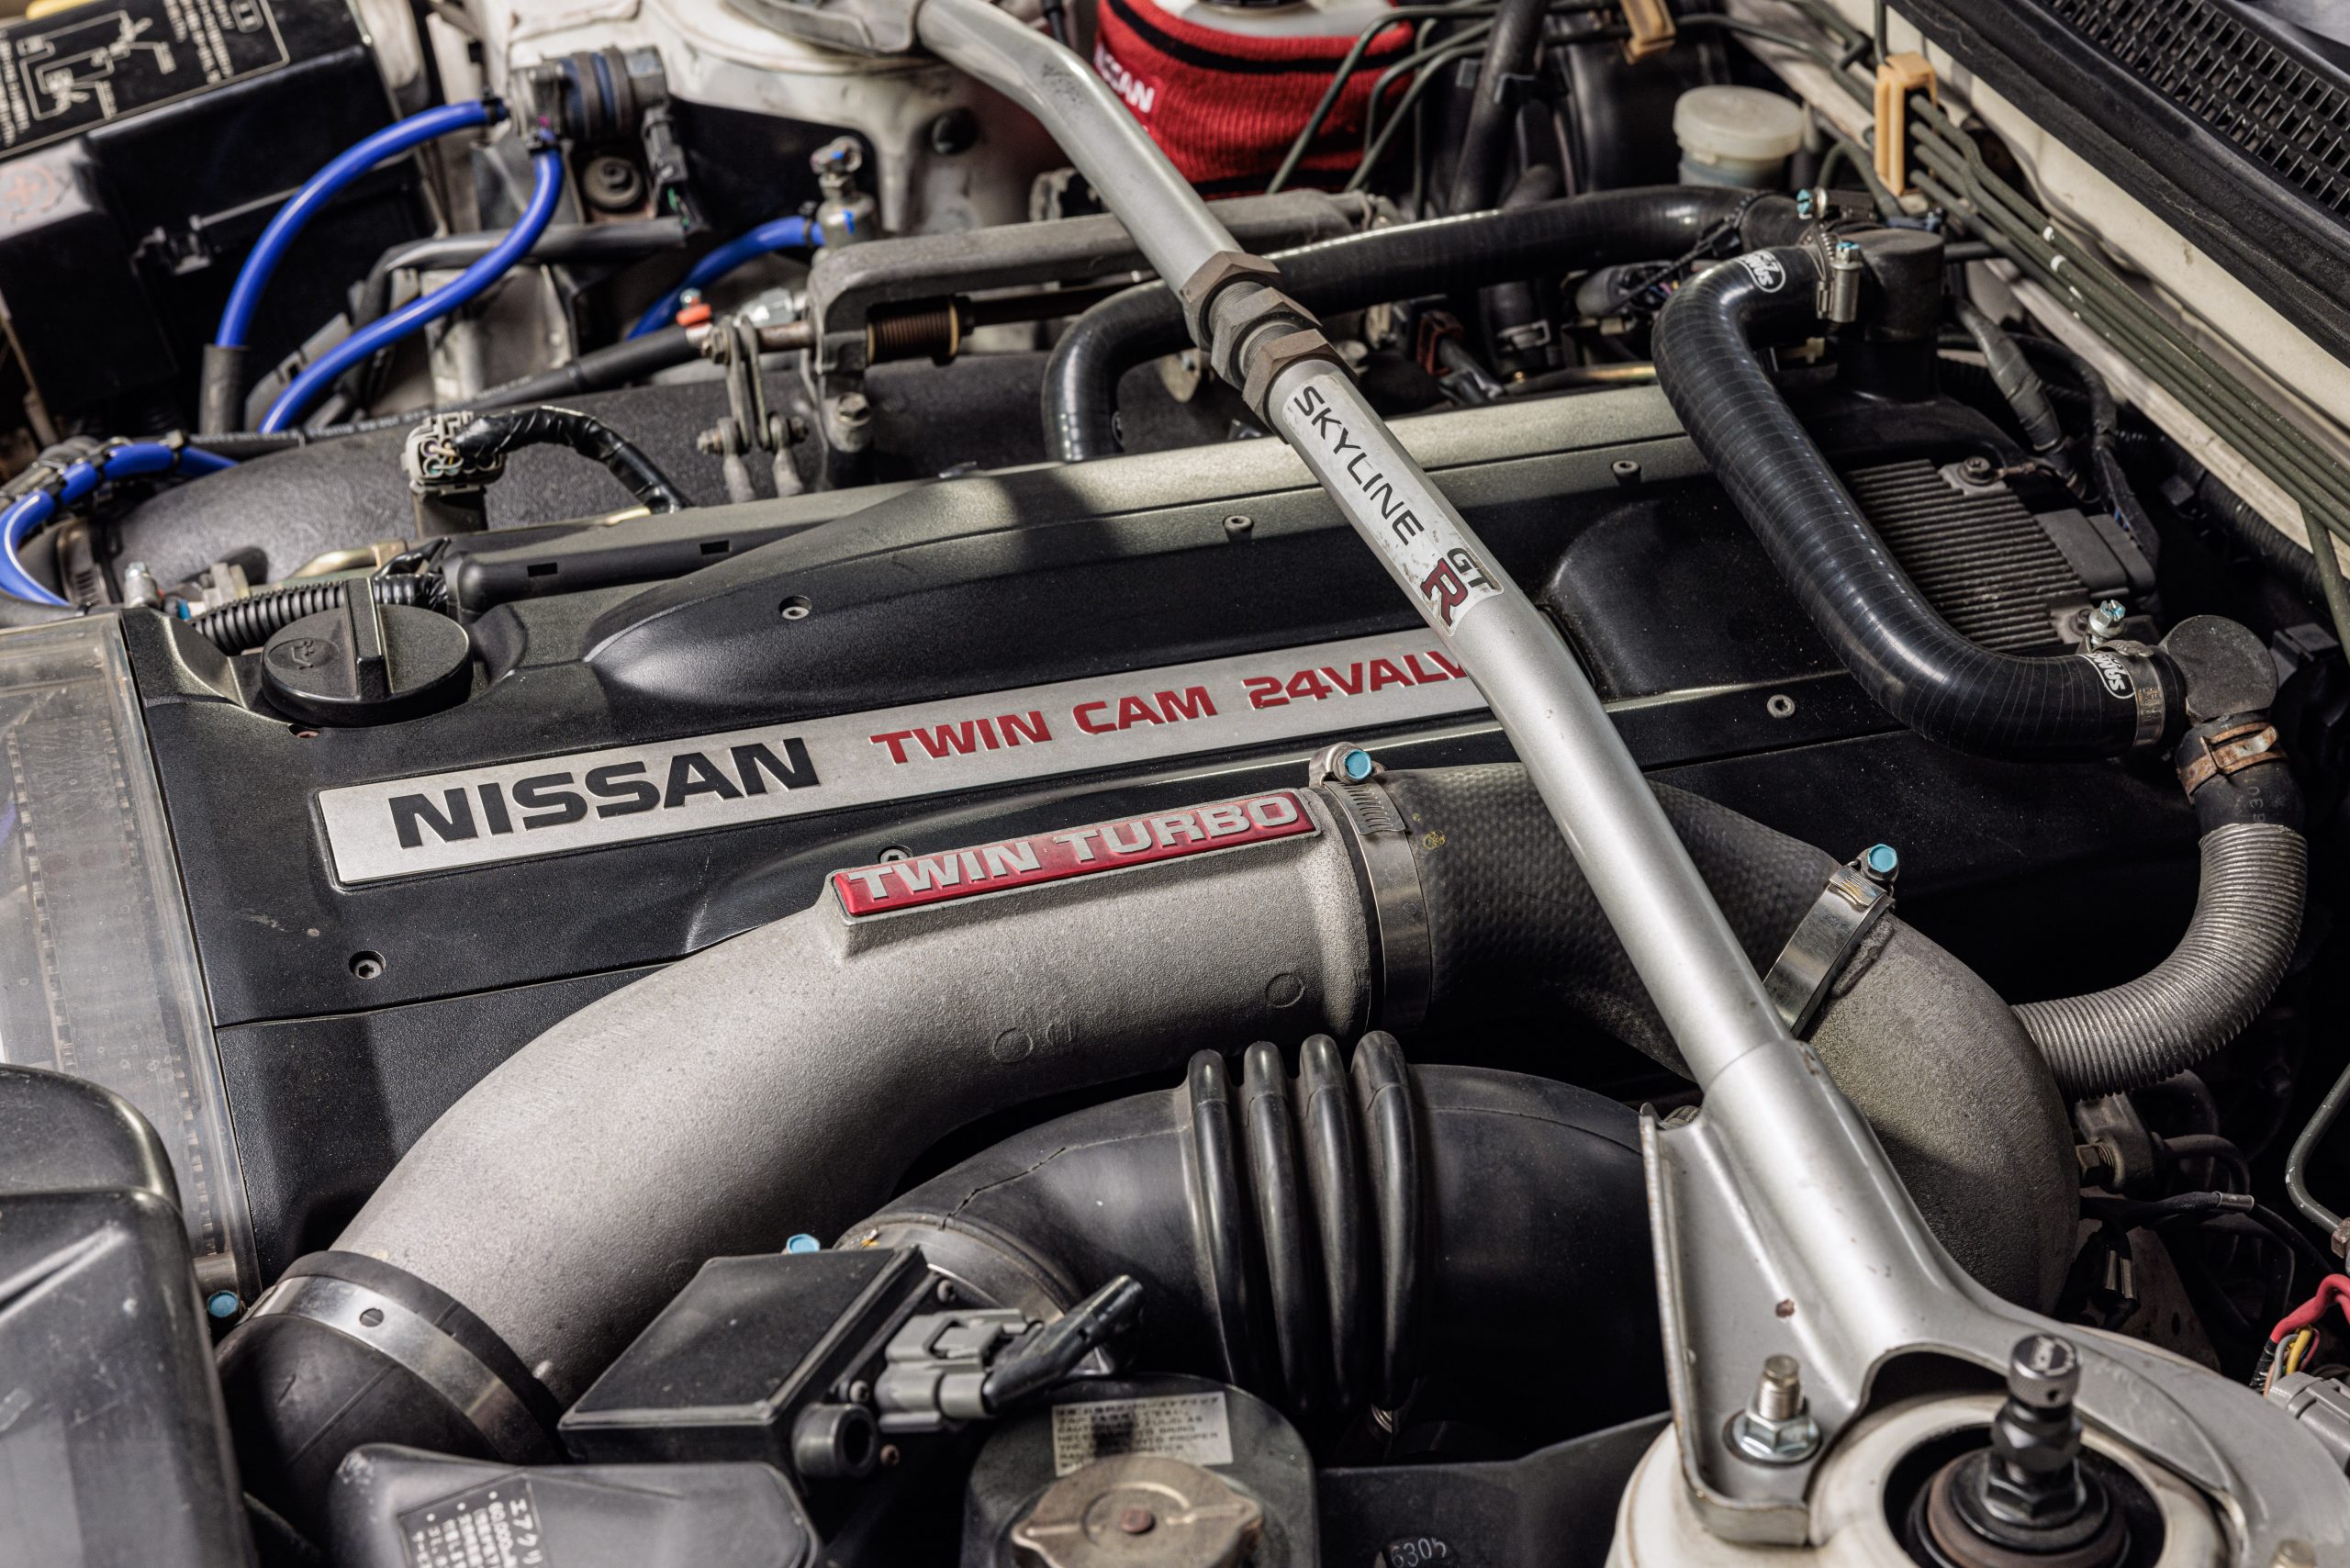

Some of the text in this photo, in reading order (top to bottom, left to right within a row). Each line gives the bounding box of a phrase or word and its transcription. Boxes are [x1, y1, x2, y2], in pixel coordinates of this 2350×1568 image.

[1293, 386, 1426, 546] SKYLINE
[388, 650, 1468, 849] NISSAN TWIN CAM 24VALV
[847, 795, 1300, 900] TWIN TURBO
